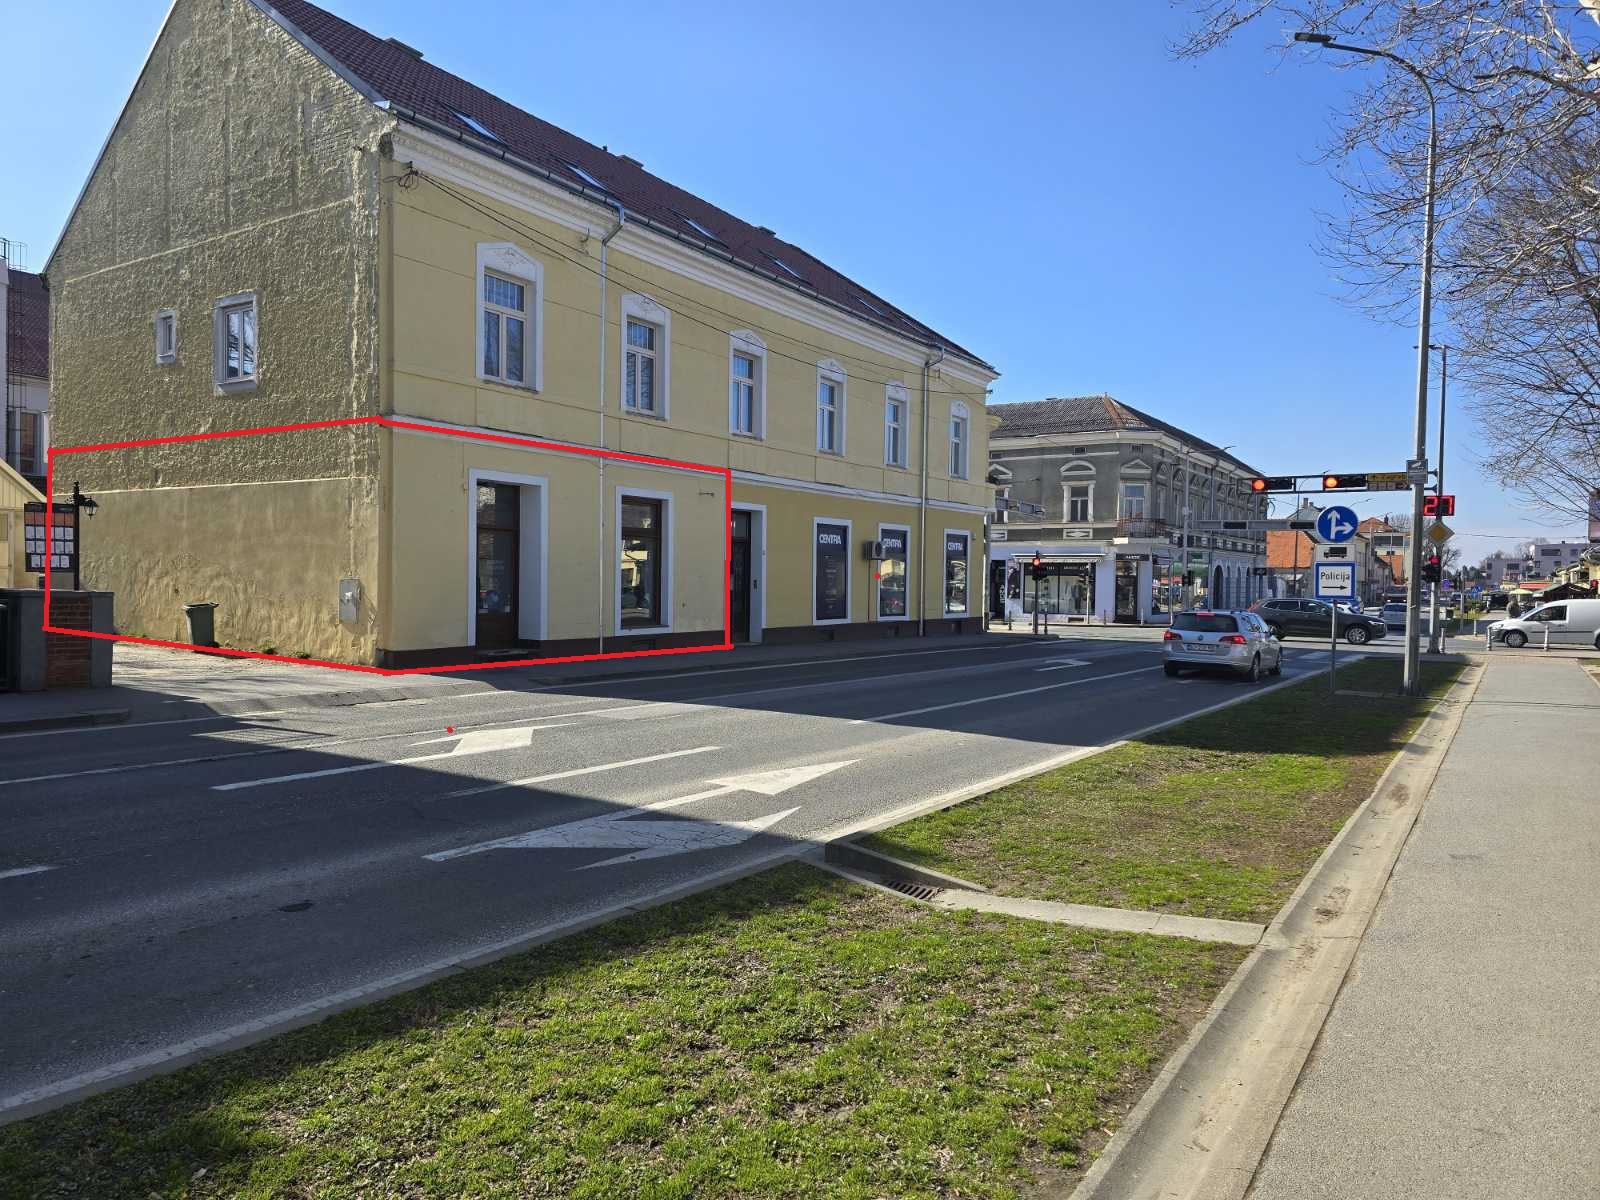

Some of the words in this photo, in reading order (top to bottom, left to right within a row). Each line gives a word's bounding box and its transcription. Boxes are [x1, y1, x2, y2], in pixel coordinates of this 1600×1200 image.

[1424, 496, 1453, 516] 27
[819, 534, 842, 545] CENTRA
[1320, 571, 1350, 582] Policija
